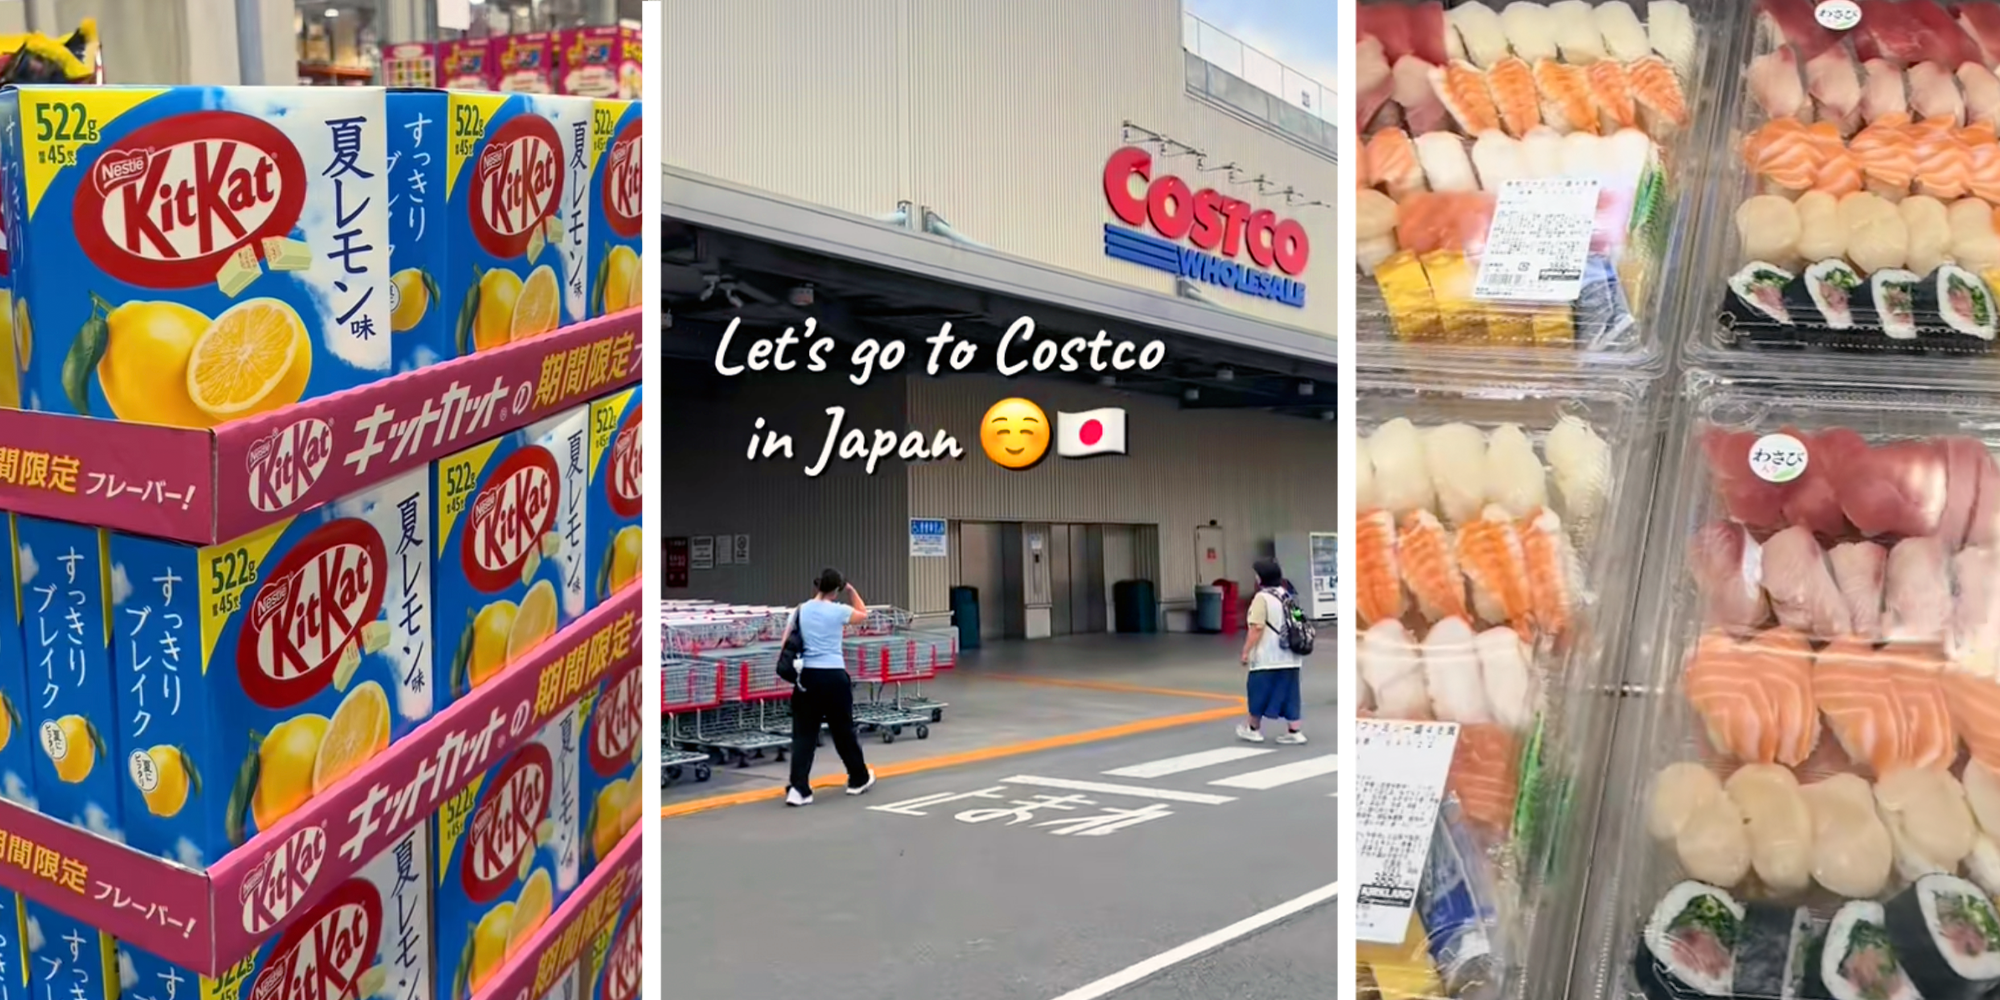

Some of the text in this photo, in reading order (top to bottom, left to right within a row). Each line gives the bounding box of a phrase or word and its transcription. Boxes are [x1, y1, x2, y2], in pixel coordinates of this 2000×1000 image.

[36, 102, 98, 141] 522g
[456, 104, 484, 138] 522g
[122, 142, 274, 258] KitKat
[322, 115, 376, 341] 夏レモン味
[404, 112, 432, 242] すっきり
[492, 138, 553, 234] KitKat
[569, 120, 588, 298] 夏レモン味
[618, 137, 642, 216] Kit
[1103, 146, 1309, 276] COSTCO
[1177, 246, 1306, 308] WHOLESALE
[343, 375, 510, 476] キットカット
[512, 381, 533, 415] の
[531, 331, 635, 411] 期間限定
[1753, 447, 1805, 467] わさび
[86, 472, 197, 511] フレーバー!
[258, 420, 330, 510] KitKat
[446, 461, 476, 497] 522g
[484, 468, 548, 569] KitKat
[57, 546, 86, 688] すっきり
[211, 547, 257, 595] 522g
[272, 546, 369, 677] KitKat
[395, 491, 426, 694] 夏レモン味
[33, 583, 59, 710] ブレイク
[126, 605, 151, 738] ブレイク
[152, 566, 183, 716] すっきり
[338, 706, 507, 862] キットカット
[510, 700, 530, 737] の
[531, 610, 635, 725] 期間限定
[483, 767, 542, 879] KitKat
[866, 786, 1176, 836] 止まれ
[94, 881, 197, 939] フレーバー!
[252, 830, 323, 932] KitKat
